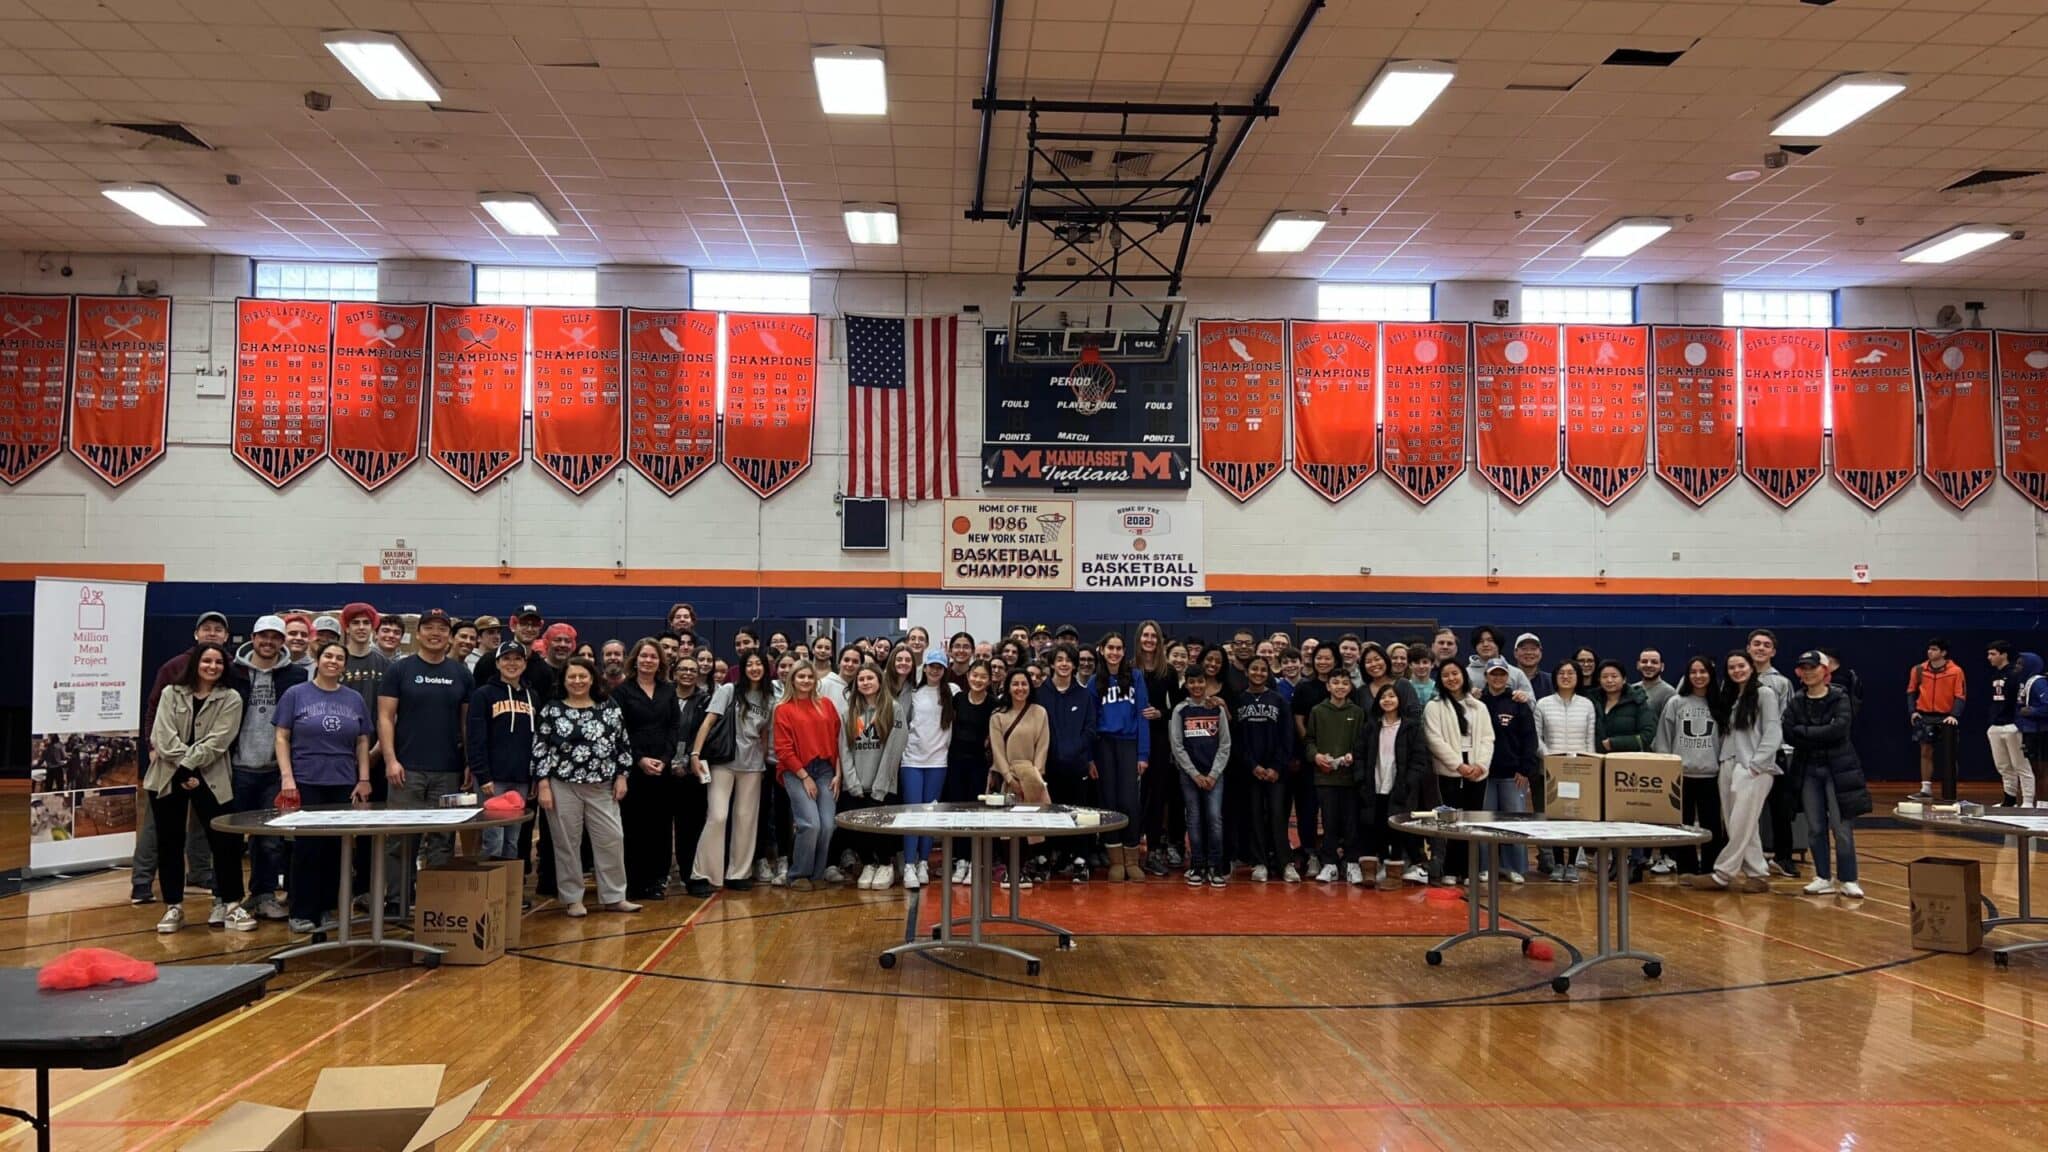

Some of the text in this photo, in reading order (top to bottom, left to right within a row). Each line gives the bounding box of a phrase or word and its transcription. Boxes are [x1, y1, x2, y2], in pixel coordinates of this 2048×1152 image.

[244, 306, 323, 325] GIRLS LACROSSE
[345, 310, 373, 325] BOYS
[562, 314, 591, 324] GOLF
[479, 313, 517, 332] TENNIS
[1327, 331, 1372, 351] LACROSSE
[1578, 332, 1635, 346] WRESTLING
[1745, 336, 1776, 351] GIRLS
[1781, 335, 1821, 352] SOCCER
[79, 340, 165, 351] CHAMPIONS
[240, 343, 326, 353] CHAMPIONS
[336, 347, 422, 358] CHAMPIONS
[438, 352, 518, 362] CHAMPIONS
[535, 350, 619, 360] CHAMPIONS
[631, 352, 713, 363] CHAMPIONS
[730, 355, 812, 366] CHAMPIONS
[1202, 362, 1281, 372] CHAMPIONS
[1386, 365, 1464, 375] CHAMPIONS
[1479, 366, 1556, 375] CHAMPIONS
[1568, 366, 1645, 375] CHAMPIONS
[1657, 367, 1734, 377] CHAMPIONS
[1832, 367, 1910, 377] CHAMPIONS
[1297, 367, 1370, 378] CHAMPIONS
[1745, 369, 1823, 378] CHAMPIONS
[242, 374, 255, 382] 92
[1050, 376, 1093, 387] PERIOD
[753, 387, 766, 395] 03
[731, 402, 743, 410] 14
[754, 402, 765, 410] 15
[796, 403, 806, 411] 17
[1002, 400, 1030, 408] FOULS
[1145, 402, 1173, 410] FOULS
[999, 433, 1031, 441] POINTS
[1057, 432, 1090, 442] MATCH
[1143, 434, 1175, 442] POINTS
[1046, 450, 1128, 467] MANHASSET
[1002, 450, 1042, 478] M
[1131, 451, 1172, 480] M
[1041, 465, 1130, 481] Indians
[978, 505, 1037, 513] HOME OF THE
[1117, 507, 1134, 515] HOME
[1147, 506, 1160, 514] THE
[988, 516, 1027, 532] 1986
[1126, 516, 1151, 526] 2022
[968, 533, 1046, 544] NEW YORK STATE
[952, 548, 1063, 563] BASKETBALL
[1153, 553, 1183, 561] STATE
[383, 558, 414, 566] OCCUPANCY
[957, 564, 1060, 579] CHAMPIONS
[1081, 562, 1198, 574] BASKETBALL
[1086, 575, 1194, 587] CHAMPIONS
[73, 632, 109, 642] Million
[79, 644, 103, 654] Meal
[73, 656, 108, 668] Project
[425, 675, 453, 685] bolster
[1683, 719, 1714, 737] U
[1614, 771, 1663, 788] Rise
[423, 910, 469, 928] Rise
